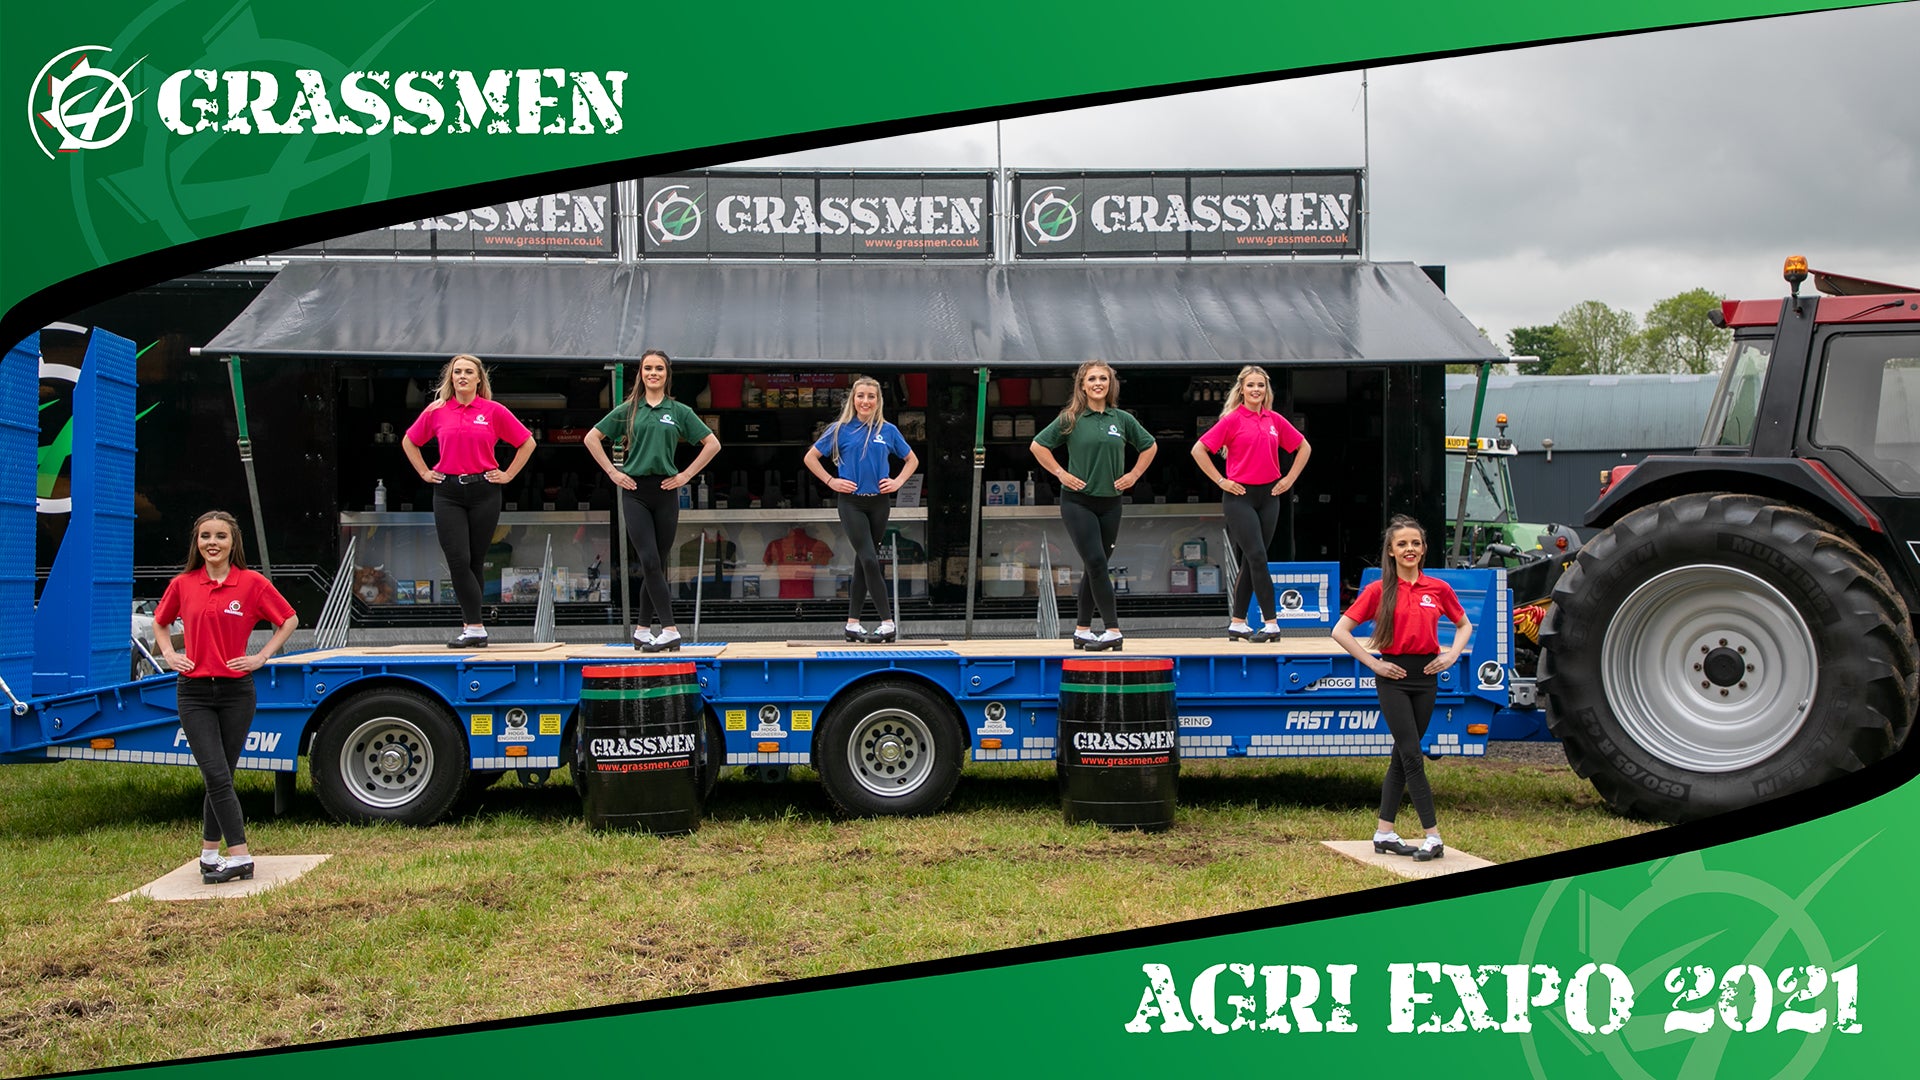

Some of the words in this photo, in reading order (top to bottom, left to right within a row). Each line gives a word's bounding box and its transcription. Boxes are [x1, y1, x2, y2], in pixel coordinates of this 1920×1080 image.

[716, 195, 983, 234] GRASSMEN
[1090, 193, 1352, 233] GRASSMEN
[484, 236, 603, 247] www.grassmen.co.uk
[865, 237, 980, 249] www.grassmen.co.uk
[1236, 234, 1348, 247] www.grassmen.co.uk
[1319, 678, 1352, 687] HOGG
[1179, 717, 1211, 726] ERING
[1285, 710, 1335, 730] FAST
[1338, 710, 1380, 730] TOW
[244, 731, 282, 752] OW
[590, 734, 696, 757] GRASSMEN
[1073, 731, 1175, 750] GRASSMEN
[597, 758, 690, 773] www.grassmen.com
[1080, 755, 1170, 768] www.grassmen.com
[1613, 754, 1685, 798] 650/65
